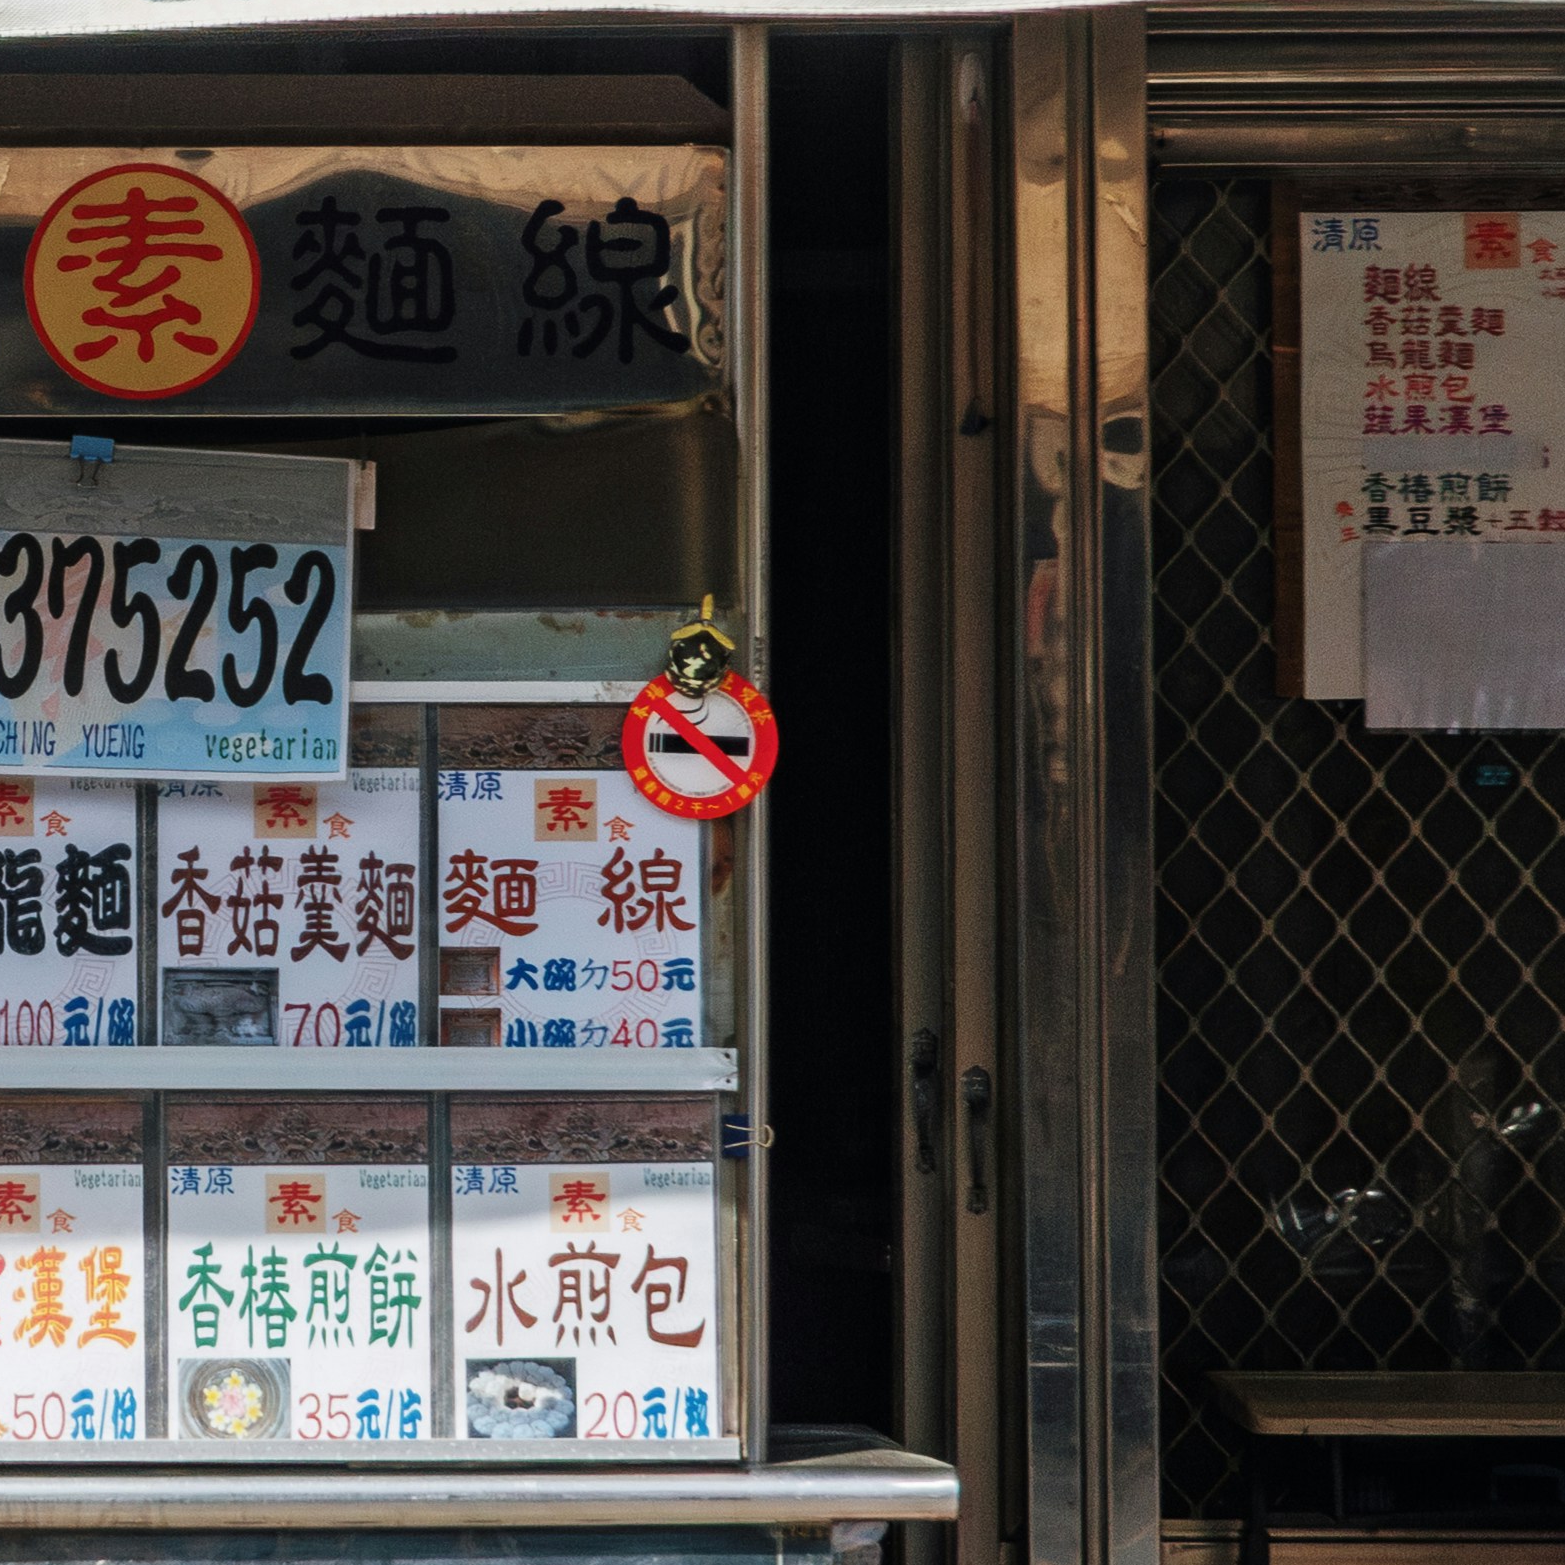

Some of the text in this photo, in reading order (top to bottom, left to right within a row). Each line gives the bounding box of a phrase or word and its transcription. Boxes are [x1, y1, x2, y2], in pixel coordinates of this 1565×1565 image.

[1365, 373, 1476, 403] 水煎包
[82, 722, 146, 759] YUENG
[438, 772, 503, 801] 清原
[161, 845, 416, 963] 香菇羹麵
[443, 846, 696, 936] 麵線
[171, 1167, 234, 1195] 清原
[455, 1167, 519, 1195] 清原
[179, 1241, 422, 1349] 香椿煎餅
[465, 1240, 706, 1348] 水煎包
